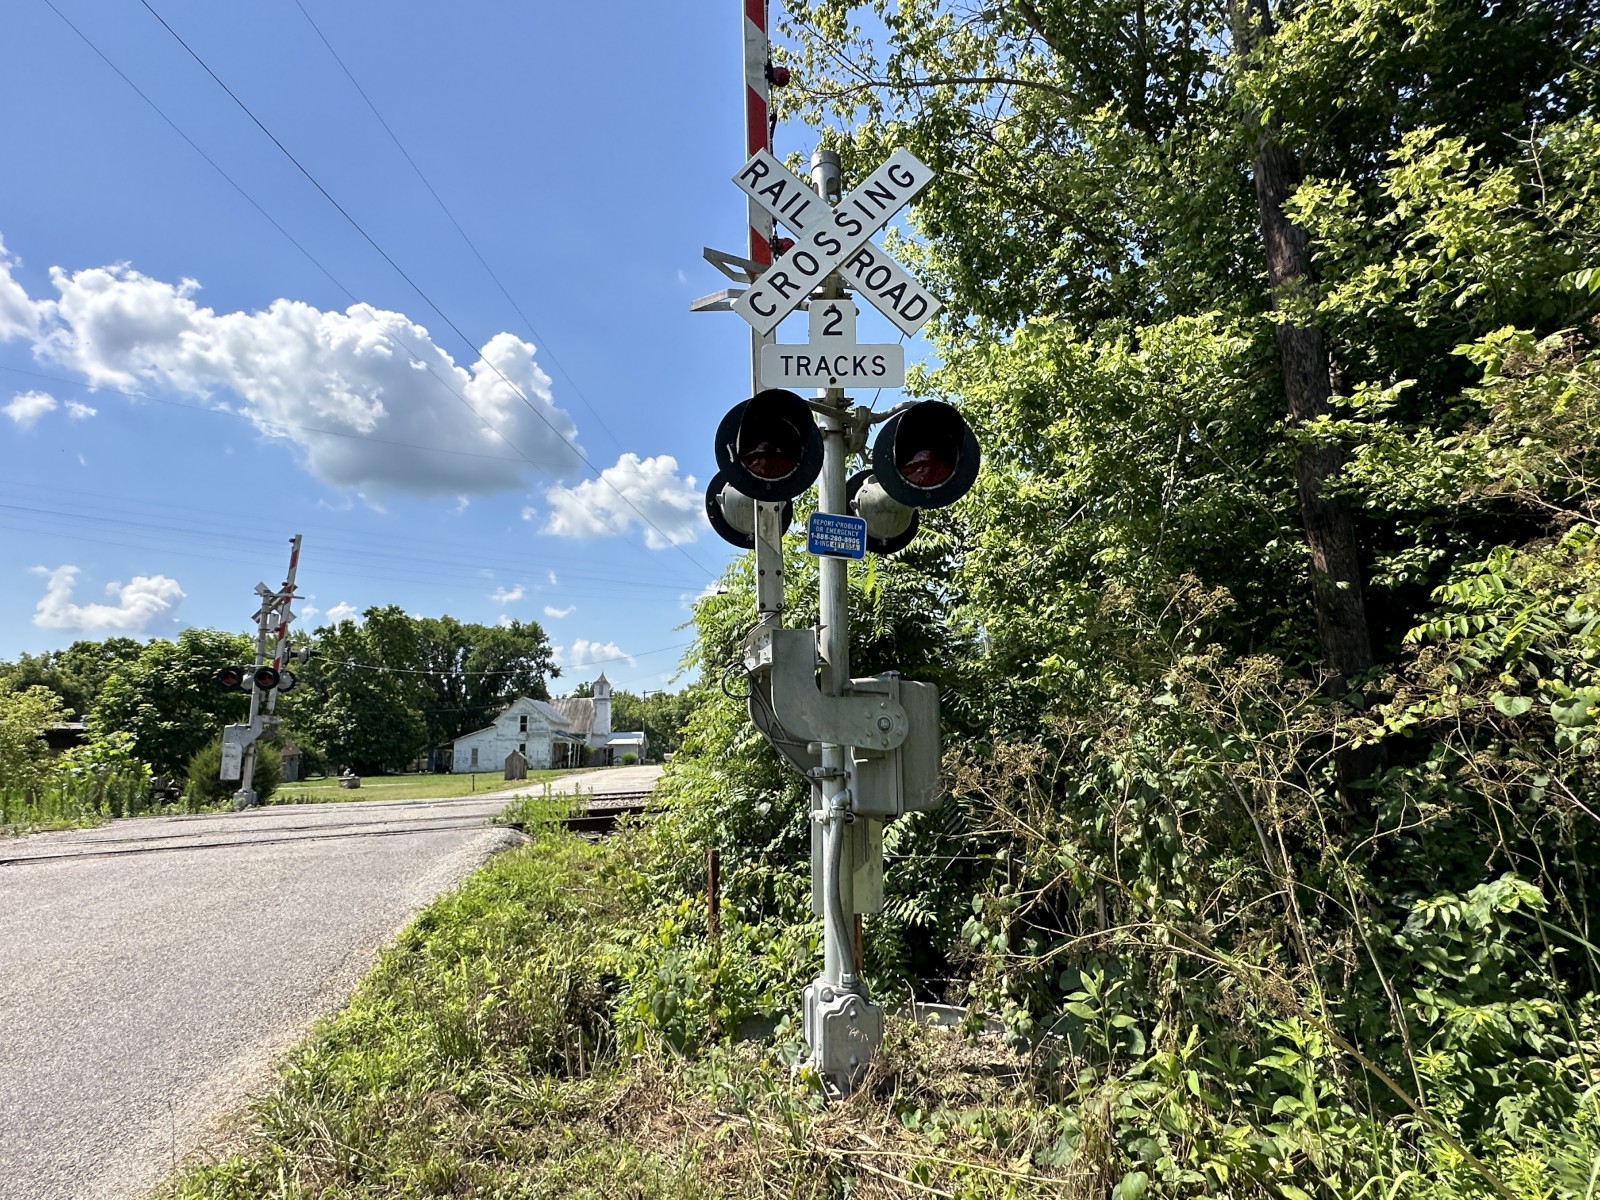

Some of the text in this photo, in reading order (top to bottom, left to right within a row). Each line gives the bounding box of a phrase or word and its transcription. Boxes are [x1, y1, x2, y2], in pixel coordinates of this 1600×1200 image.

[740, 158, 928, 322] RAIL ROAD
[749, 163, 915, 318] CROSSING
[822, 308, 843, 336] 2
[780, 355, 886, 377] TRACKS
[826, 527, 859, 537] EMERGENCY
[835, 521, 863, 530] PROBLEM
[811, 532, 860, 544] 1-888-280-8906
